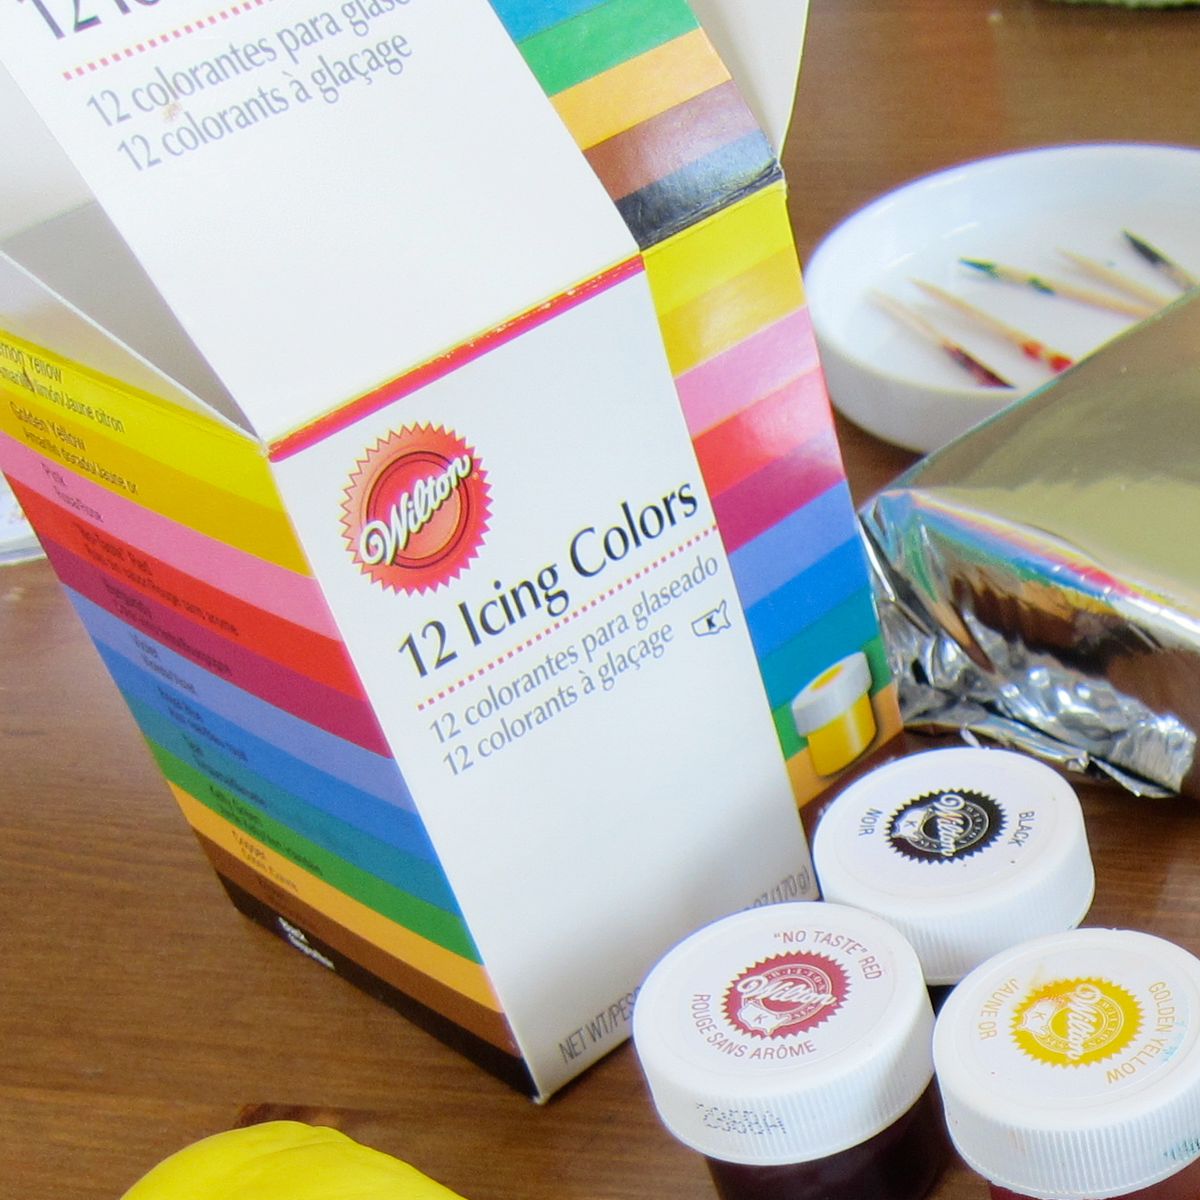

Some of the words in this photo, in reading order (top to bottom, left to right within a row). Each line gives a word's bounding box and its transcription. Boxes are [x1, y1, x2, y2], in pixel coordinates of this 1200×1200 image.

[86, 89, 131, 128] 12
[131, 36, 278, 107] colorantes
[276, 12, 342, 65] para
[341, 0, 411, 37] glas
[117, 134, 162, 172] 12
[162, 85, 290, 157] colorants
[282, 70, 313, 103] à
[310, 34, 413, 105] glaçage
[358, 454, 474, 567] Wilton
[397, 620, 458, 678] 12
[457, 563, 570, 647] Icing
[569, 482, 699, 579] Colors
[429, 711, 462, 744] 12
[464, 645, 580, 727] colorantes
[581, 614, 630, 665] para
[630, 555, 719, 630] glaseado
[442, 743, 475, 776] 12
[477, 683, 579, 759] colorants
[577, 669, 597, 696] à
[597, 621, 675, 692] glaçage
[858, 808, 884, 837] NOIR
[1008, 811, 1035, 848] BLACK
[859, 955, 882, 981] RED
[980, 978, 1020, 1018] JAUNE
[1148, 981, 1175, 1033] GOLDEN
[558, 1025, 586, 1064] NET
[691, 993, 717, 1036] ROUGE
[707, 1032, 749, 1058] SANS
[750, 1039, 817, 1060] ARÔME
[977, 1019, 998, 1041] OR
[1106, 1037, 1168, 1084] YELLOW
